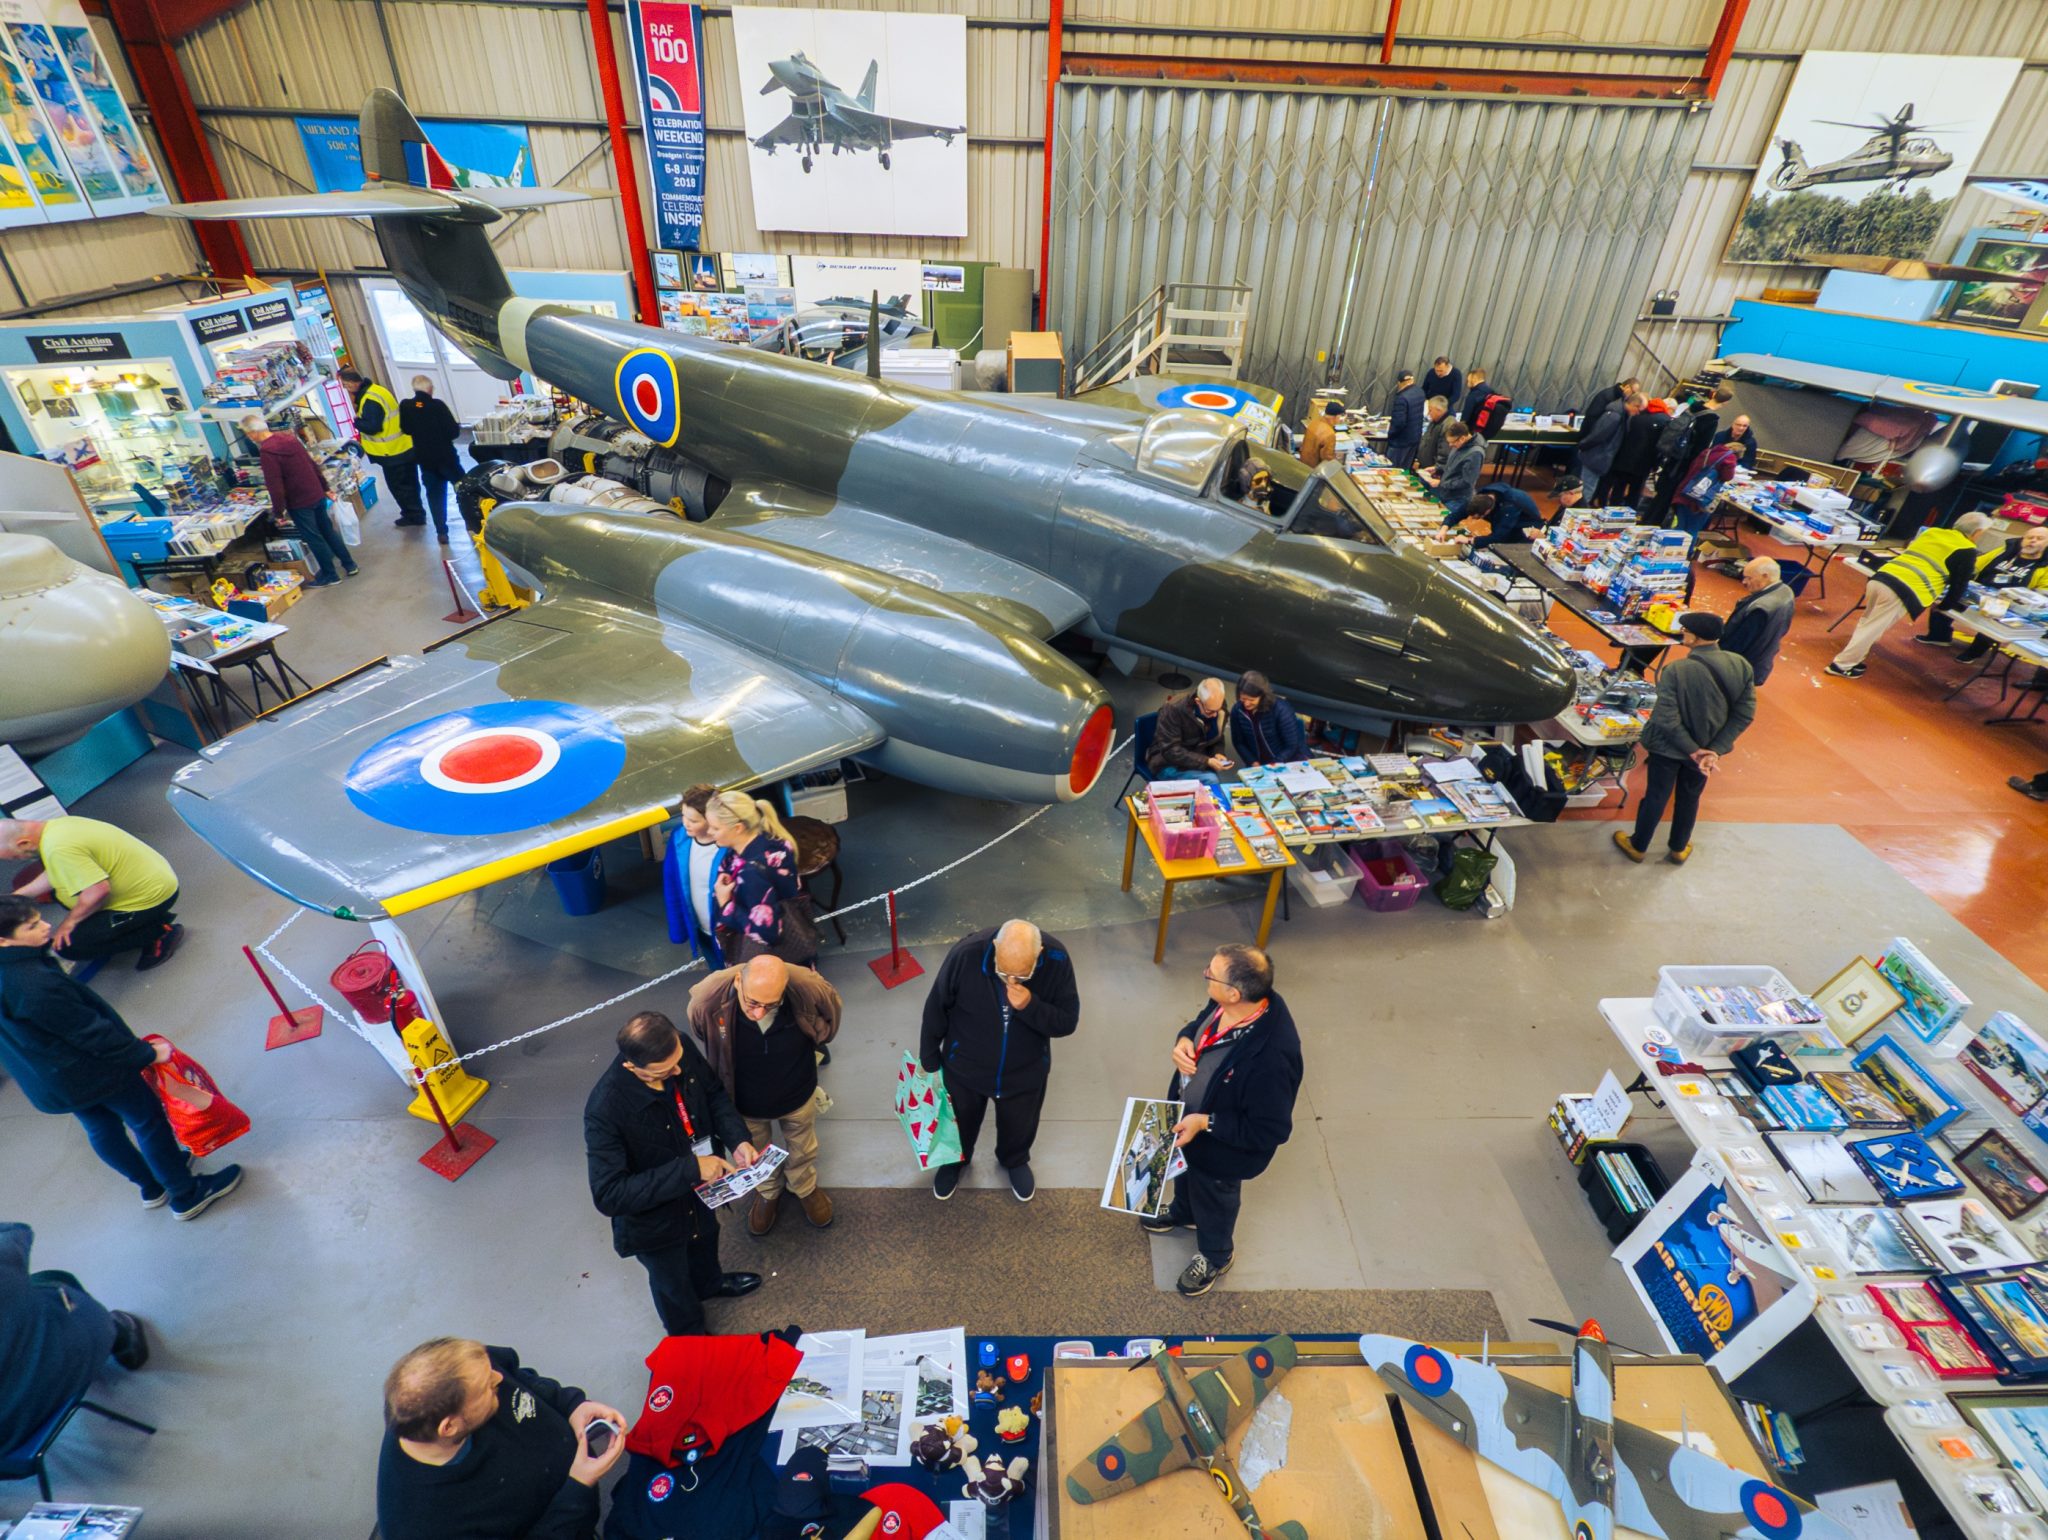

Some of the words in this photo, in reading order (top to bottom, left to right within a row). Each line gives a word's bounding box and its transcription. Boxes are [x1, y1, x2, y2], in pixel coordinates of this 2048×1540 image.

[650, 23, 674, 36] RAF
[652, 37, 688, 64] 100
[302, 125, 350, 136] MIDLAND
[654, 129, 703, 144] WEEKEND
[664, 163, 680, 174] 6-8
[682, 165, 700, 175] JULY
[674, 177, 696, 188] 2018
[42, 337, 68, 348] Civil
[70, 336, 112, 346] Aviation
[440, 1064, 460, 1085] FLOOR
[1882, 1211, 1934, 1266] SPITFIRE
[1654, 1241, 1676, 1270] AIR
[1673, 1270, 1726, 1352] SERVICES
[1700, 1287, 1731, 1331] GWR
